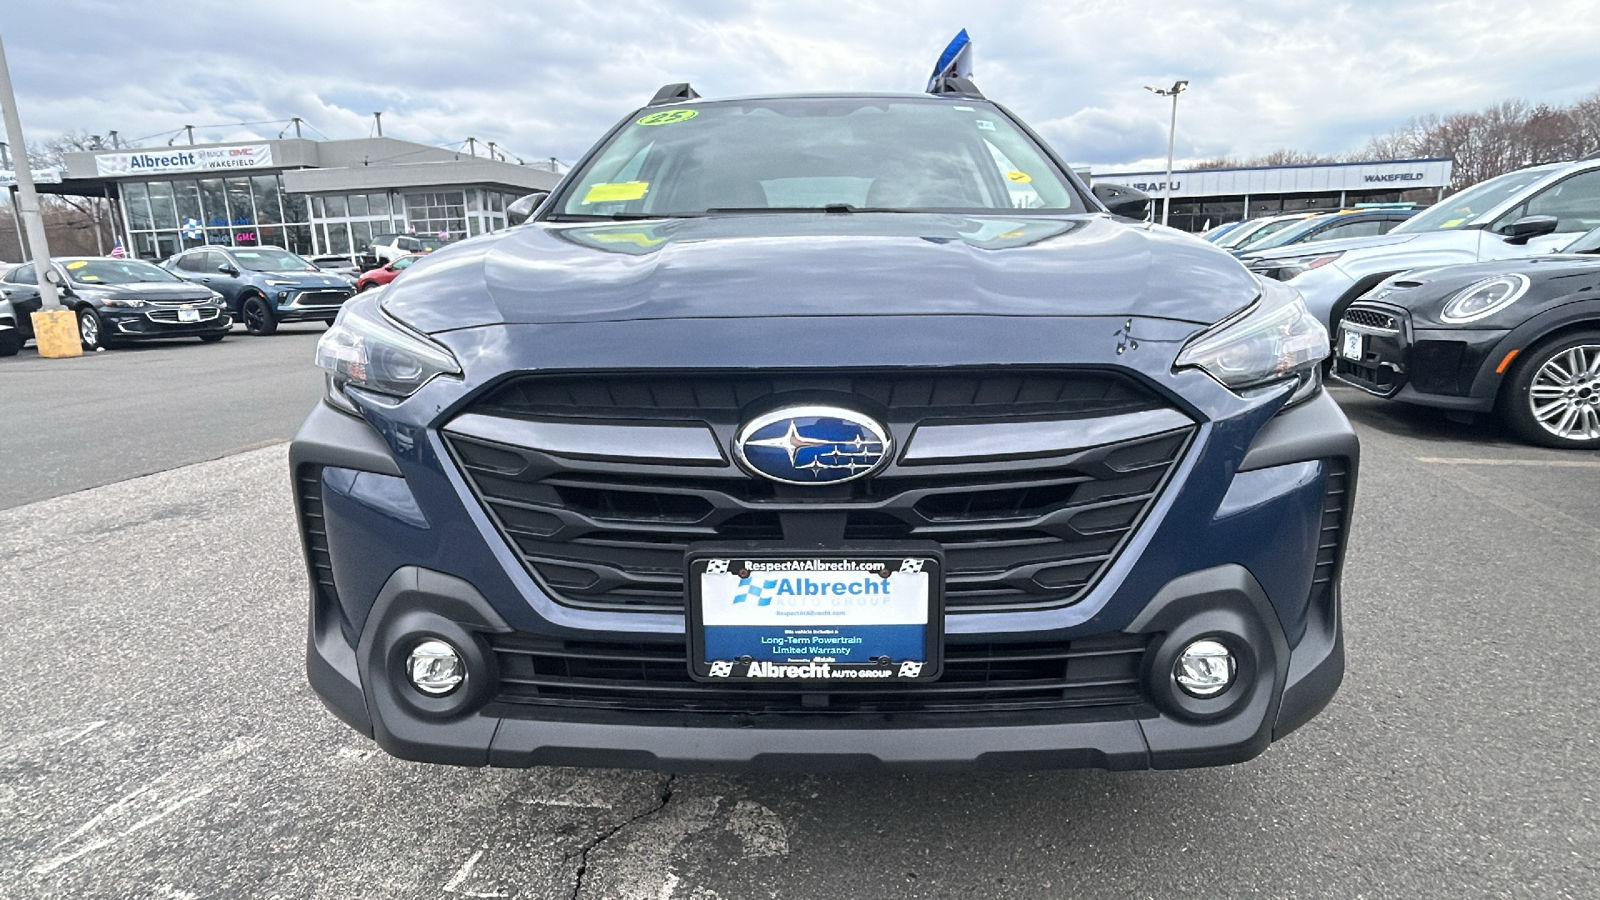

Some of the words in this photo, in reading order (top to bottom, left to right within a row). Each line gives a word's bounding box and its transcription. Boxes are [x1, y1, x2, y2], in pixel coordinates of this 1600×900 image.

[229, 148, 253, 157] GMC
[131, 152, 196, 169] Albrecht
[208, 159, 255, 169] WAKEFIELD
[1364, 172, 1424, 183] WAKEFIELD
[236, 232, 256, 241] GMC
[744, 560, 886, 573] RespectAtAlbrecht.com
[776, 577, 891, 596] Albrecht
[776, 597, 821, 607] AUTO
[831, 596, 891, 606] GROUP
[761, 636, 811, 646] Long-Term
[812, 636, 862, 644] Powertrain
[772, 646, 808, 654] Limited
[809, 646, 851, 656] Warranty
[746, 661, 831, 678] Albrecht
[831, 670, 858, 678] AUTO
[858, 670, 892, 678] GROUP
